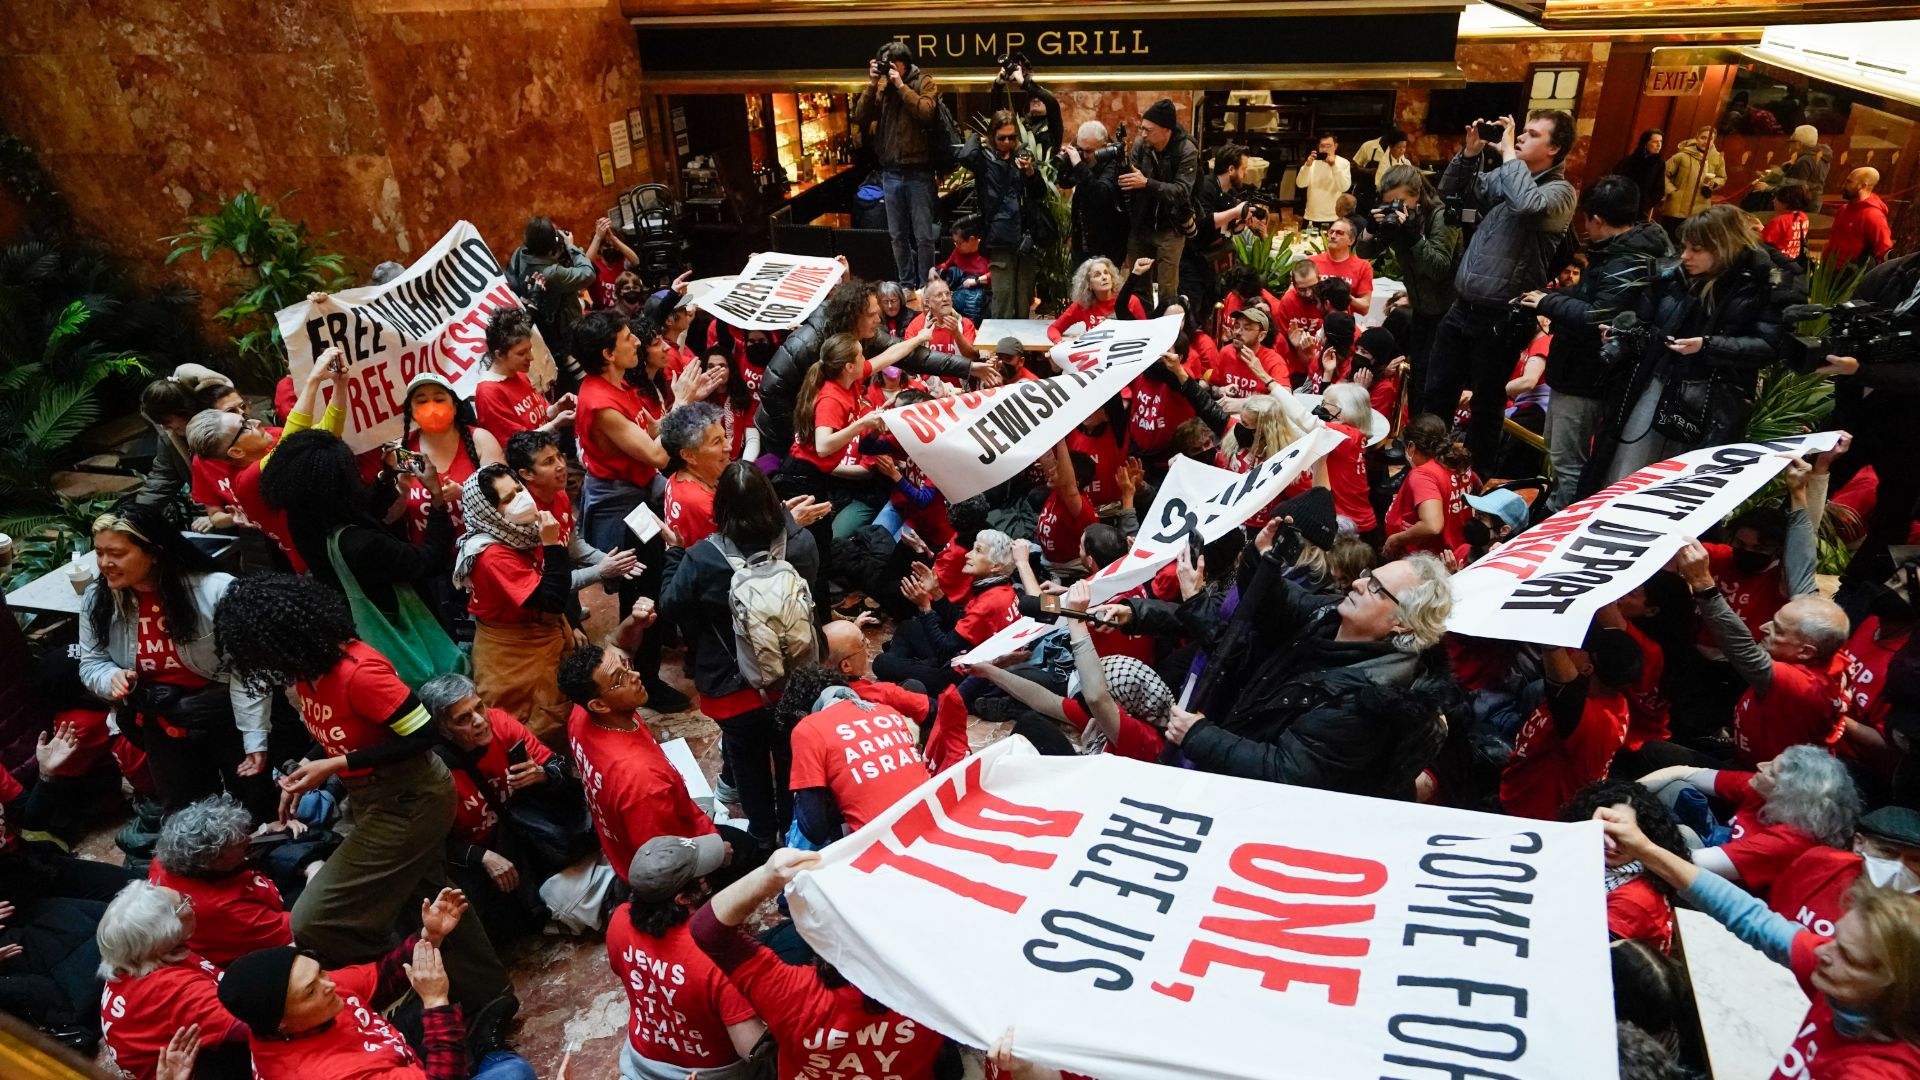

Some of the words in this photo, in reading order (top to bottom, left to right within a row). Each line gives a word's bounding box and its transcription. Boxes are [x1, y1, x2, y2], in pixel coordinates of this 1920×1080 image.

[893, 33, 1025, 57] TRUMP
[1037, 30, 1149, 55] GRILL
[1653, 71, 1688, 90] EXIT
[756, 304, 804, 324] FOR
[306, 305, 386, 366] FREE
[1226, 373, 1257, 387] STOP
[514, 395, 534, 416] NOT
[967, 377, 1071, 465] JEWISH
[1500, 519, 1668, 614] DEPORT
[835, 713, 903, 740] STOP
[850, 747, 922, 784] ISRAE
[849, 757, 1084, 914] ALL
[1069, 797, 1214, 914] FACE
[1402, 832, 1543, 959] COME
[1150, 843, 1388, 1007] ONE,
[1796, 906, 1835, 937] NO
[623, 945, 685, 985] JEWS
[1023, 908, 1155, 991] US
[630, 970, 677, 1006] SAY
[803, 1019, 916, 1050] JEWS
[808, 1050, 900, 1073] SAY
